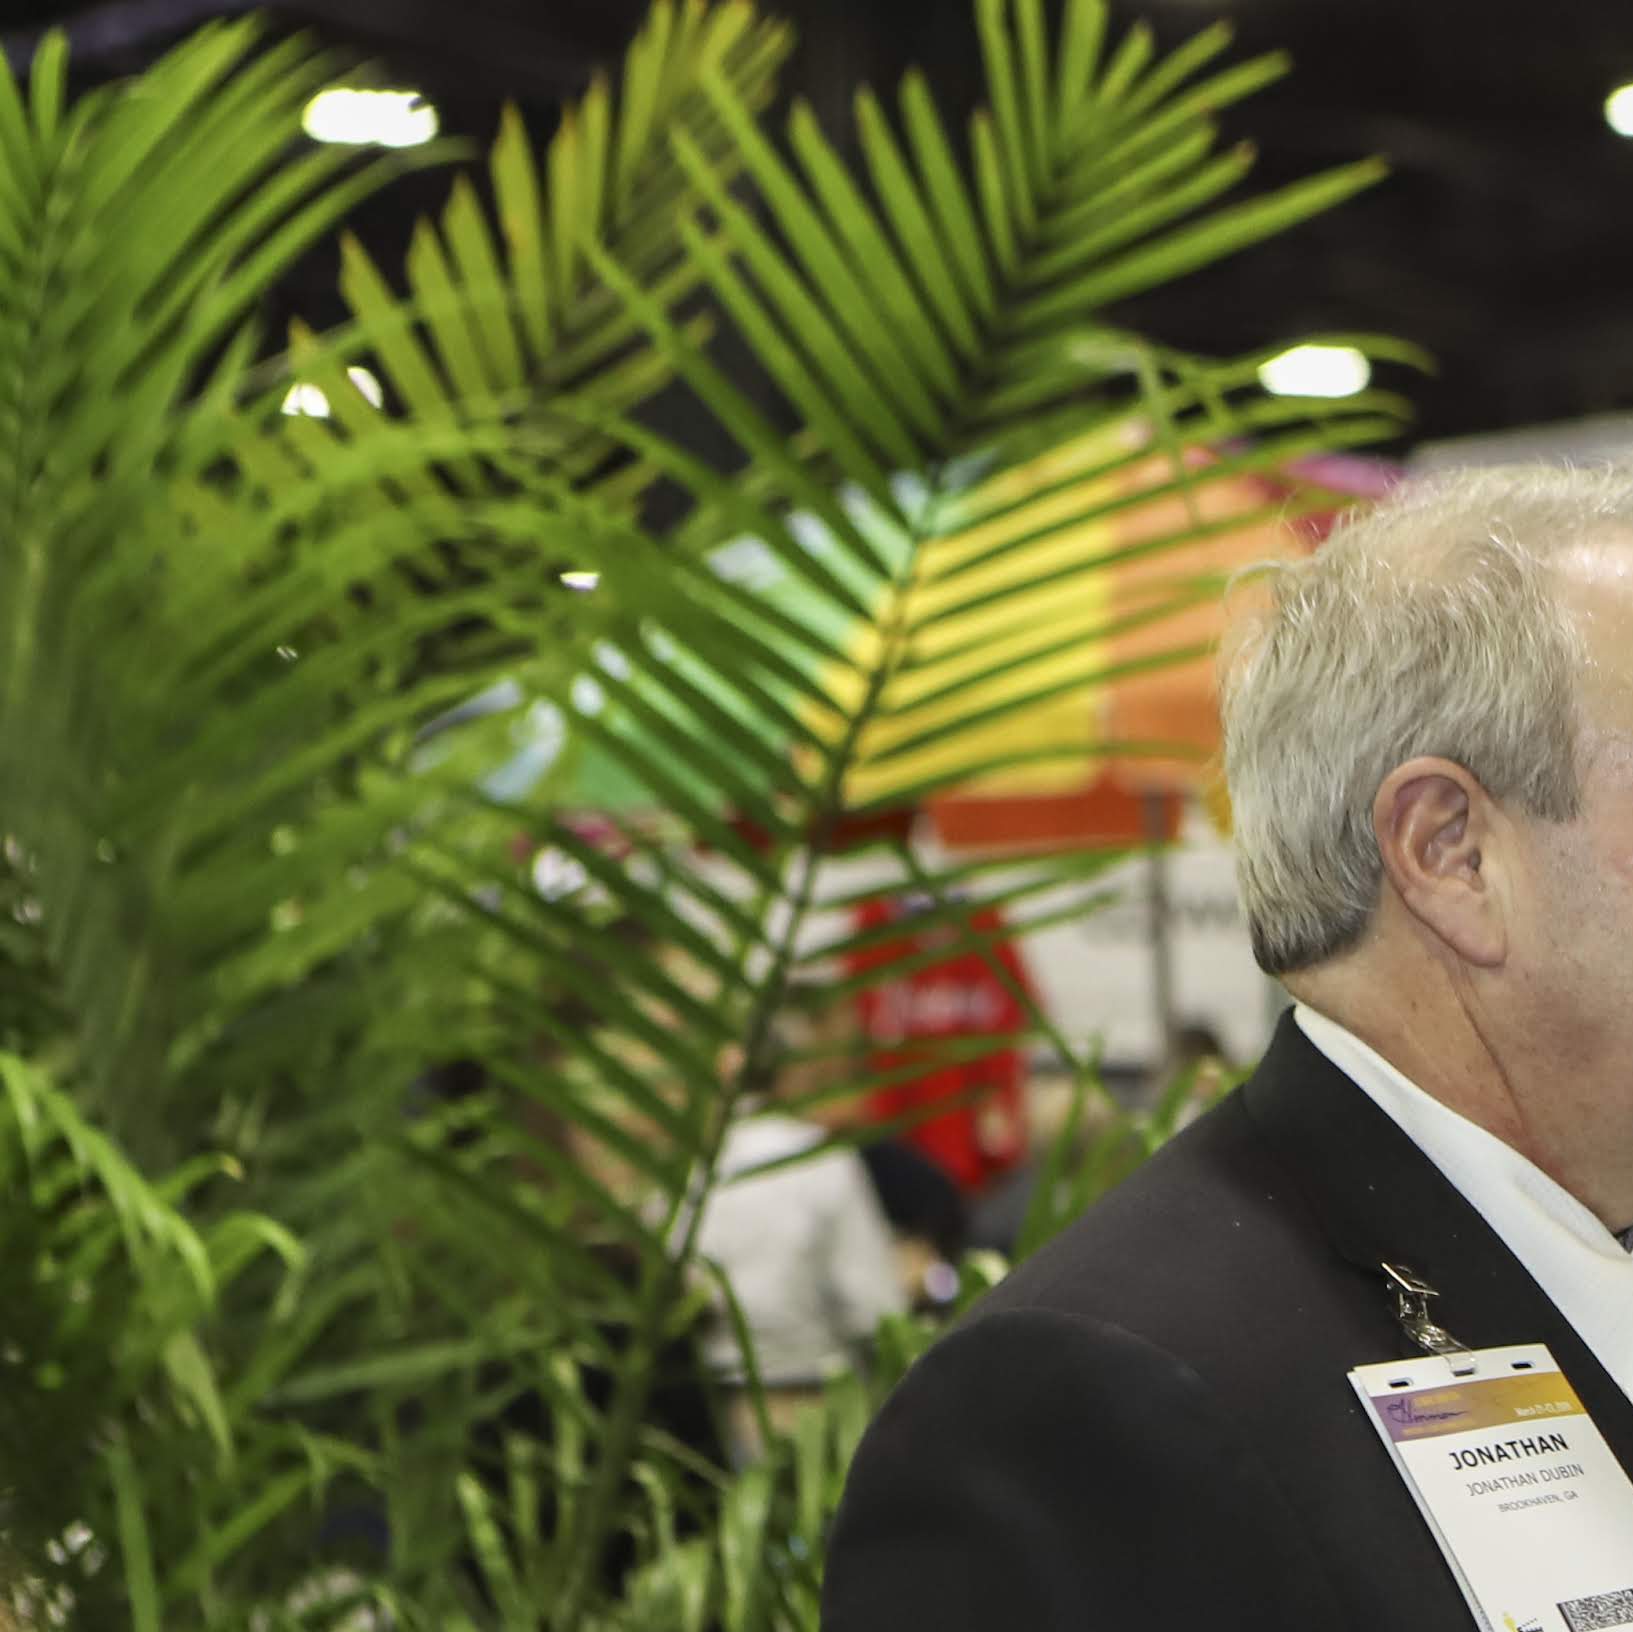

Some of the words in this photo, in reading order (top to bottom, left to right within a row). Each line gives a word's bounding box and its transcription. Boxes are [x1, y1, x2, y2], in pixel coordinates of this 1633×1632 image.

[1449, 1433, 1569, 1470] JONATHAN
[1466, 1472, 1539, 1496] JONATHAN
[1539, 1464, 1585, 1482] DUBIN
